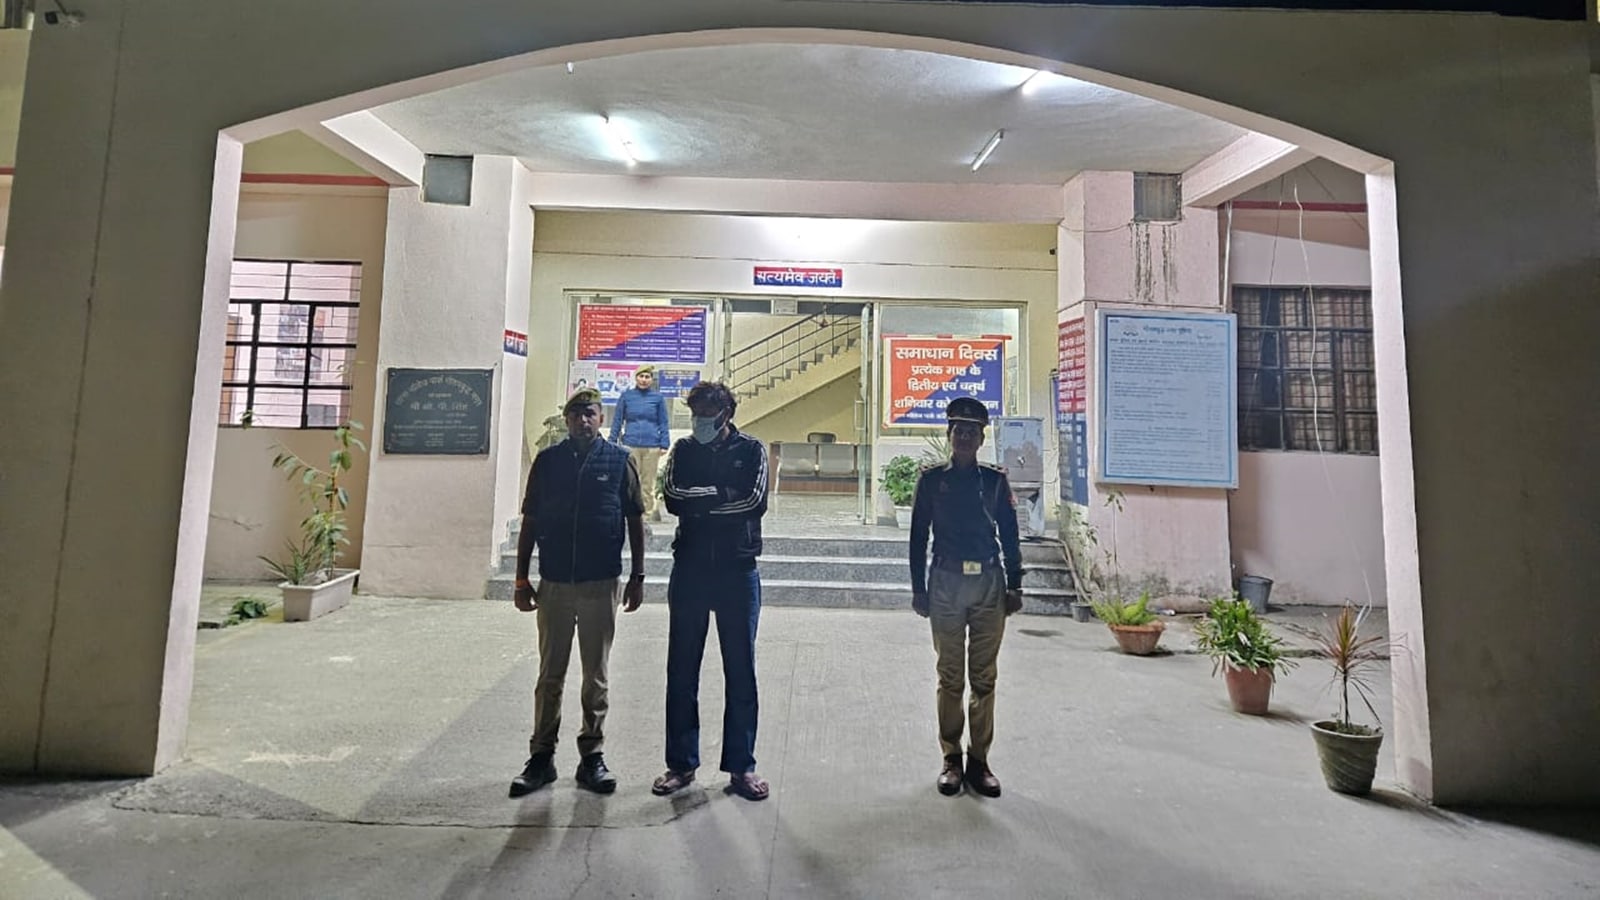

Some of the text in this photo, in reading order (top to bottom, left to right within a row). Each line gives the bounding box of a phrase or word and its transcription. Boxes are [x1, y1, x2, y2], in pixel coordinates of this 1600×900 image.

[757, 267, 837, 285] सत्यमेव जयते
[896, 343, 998, 360] समाधान दिवस
[911, 363, 944, 375] प्रत्येक
[970, 363, 981, 375] के
[907, 378, 986, 396] द्वितीय एवं चतुर्थ
[895, 396, 933, 408] शनिवार
